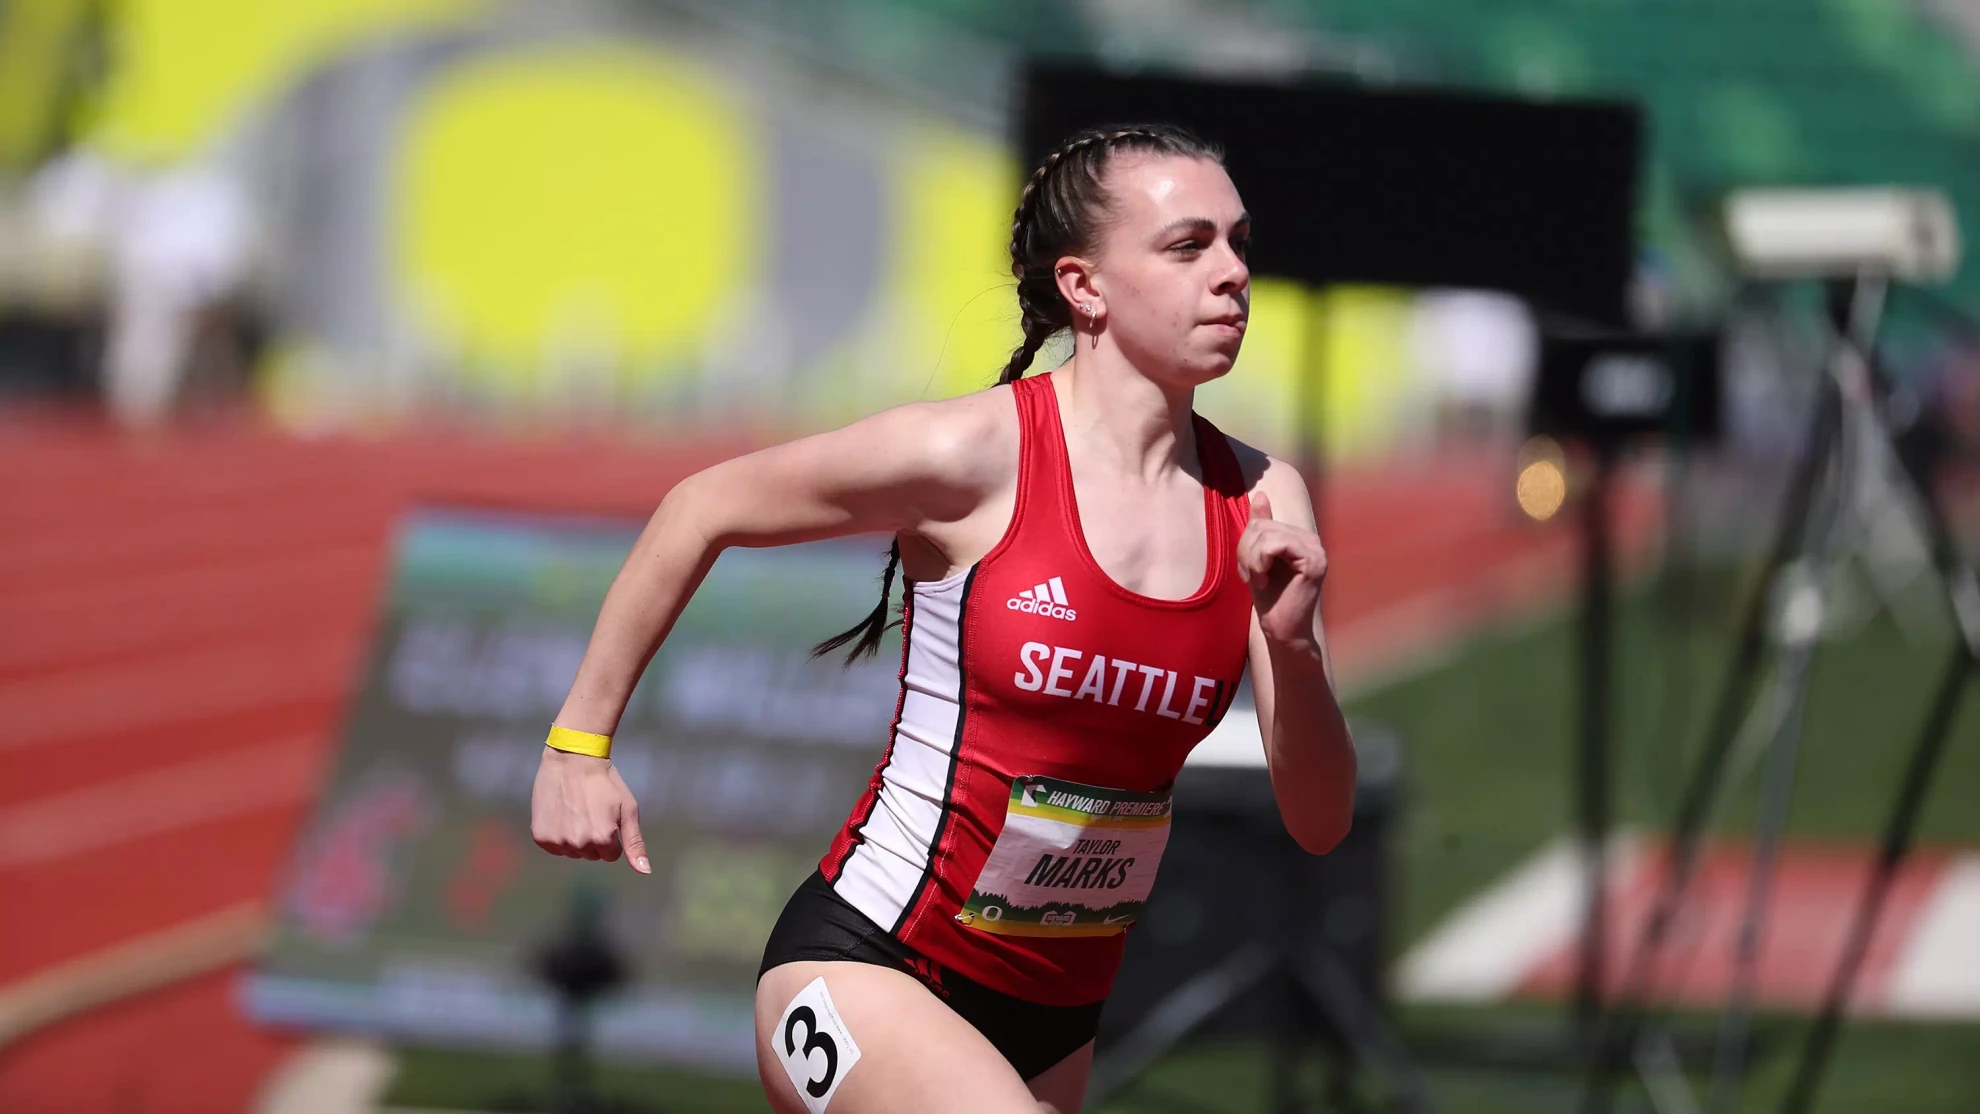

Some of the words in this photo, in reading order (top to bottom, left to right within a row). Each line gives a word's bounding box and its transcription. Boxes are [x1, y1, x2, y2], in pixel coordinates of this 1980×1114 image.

[1006, 597, 1077, 622] adidas
[1046, 790, 1111, 815] HAYWARD
[1108, 801, 1166, 816] PREMIERE
[1072, 838, 1121, 855] TAYLOR
[1024, 853, 1136, 890] MARKS
[784, 1005, 839, 1098] 3
